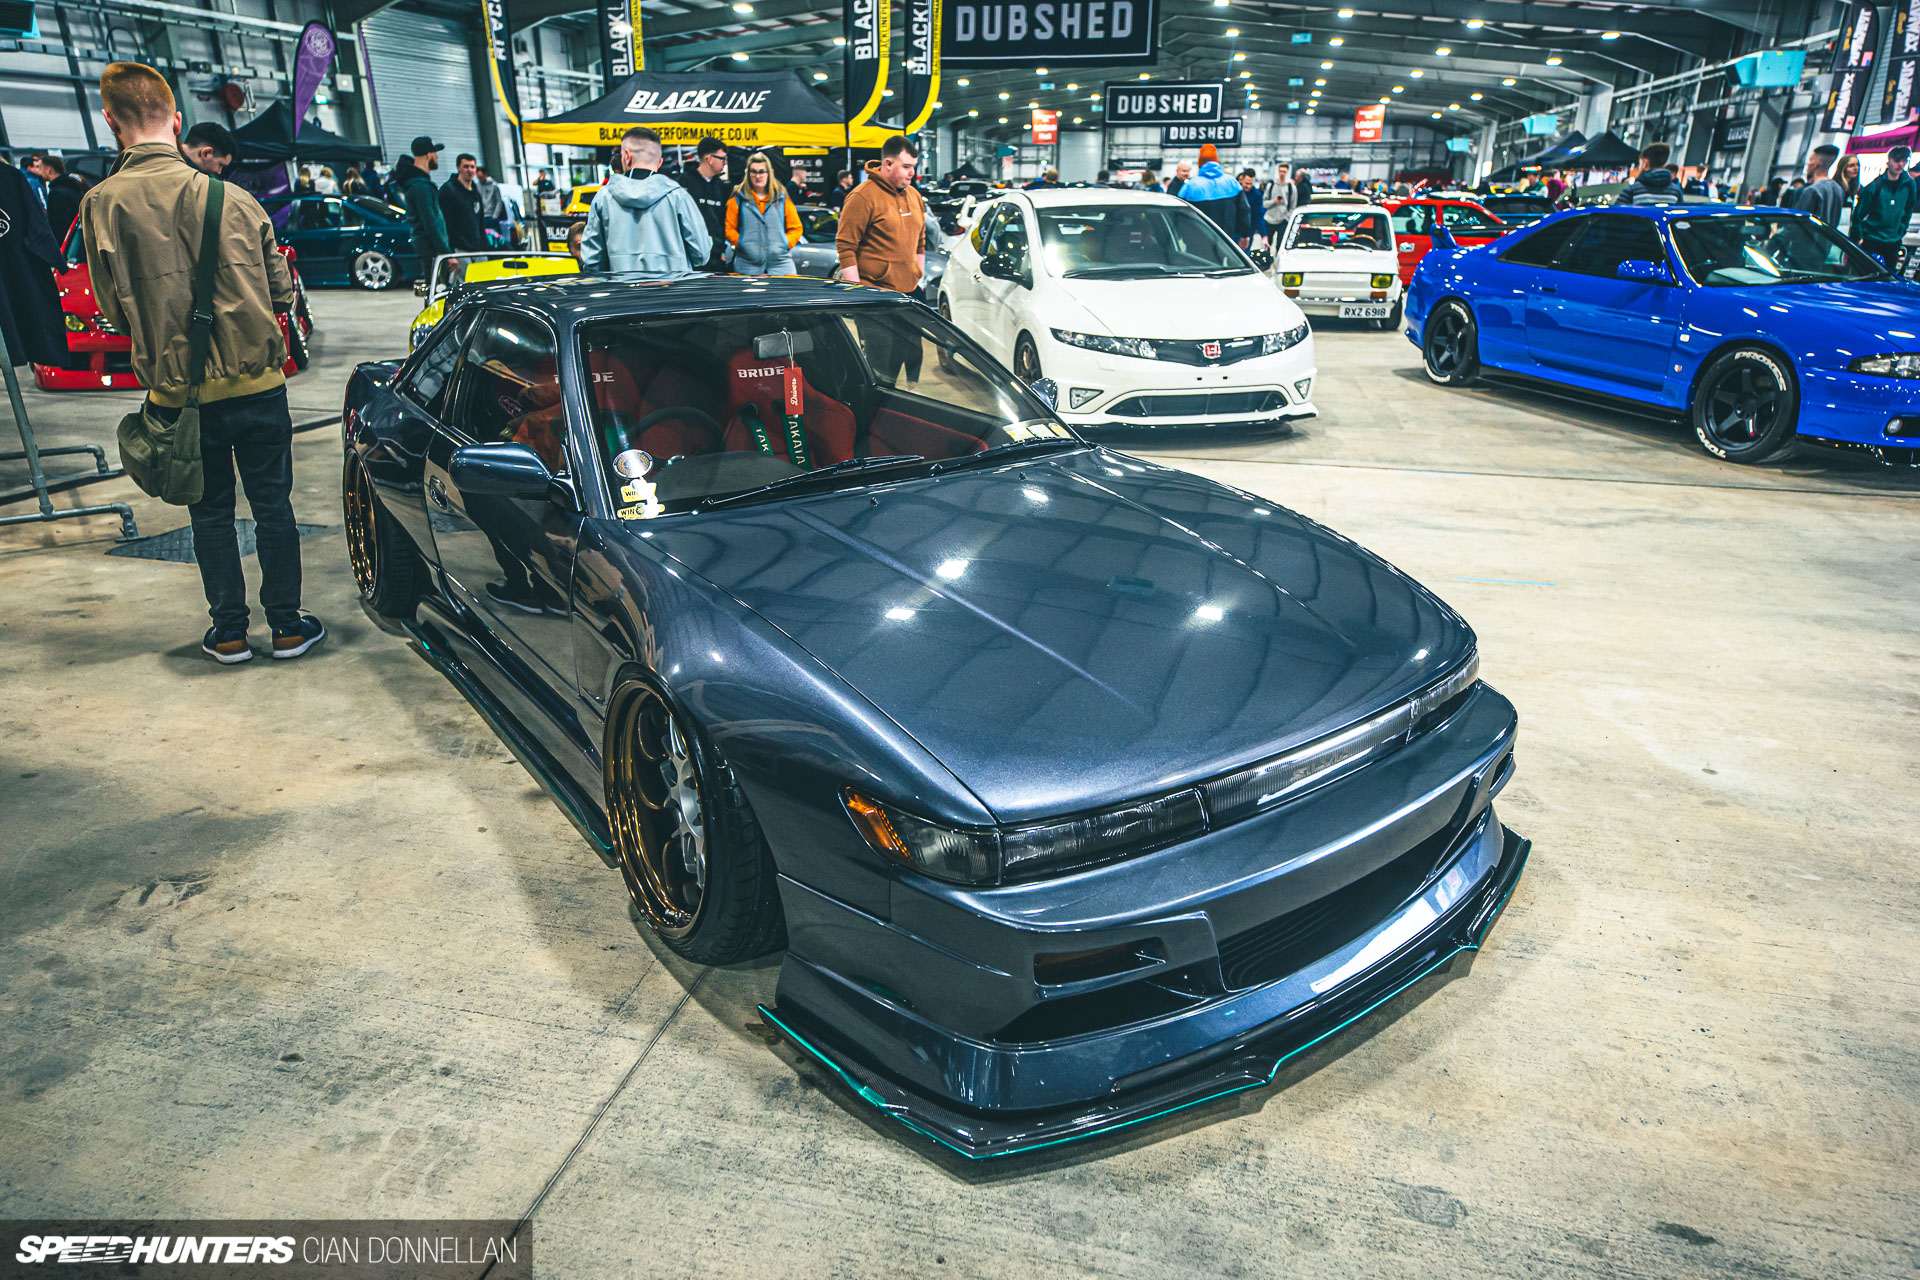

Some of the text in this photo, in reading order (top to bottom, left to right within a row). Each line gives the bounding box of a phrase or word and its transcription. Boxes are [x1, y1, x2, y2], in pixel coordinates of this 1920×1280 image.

[955, 1, 1134, 42] DUBSHED
[626, 89, 772, 110] BLACKLINE
[1117, 93, 1213, 114] DUBSHED
[599, 127, 759, 141] BLACPERFORMANCE.CO.UK
[1169, 125, 1235, 140] DUBSHED
[1344, 307, 1363, 317] RXZ
[737, 366, 785, 378] BRIDE
